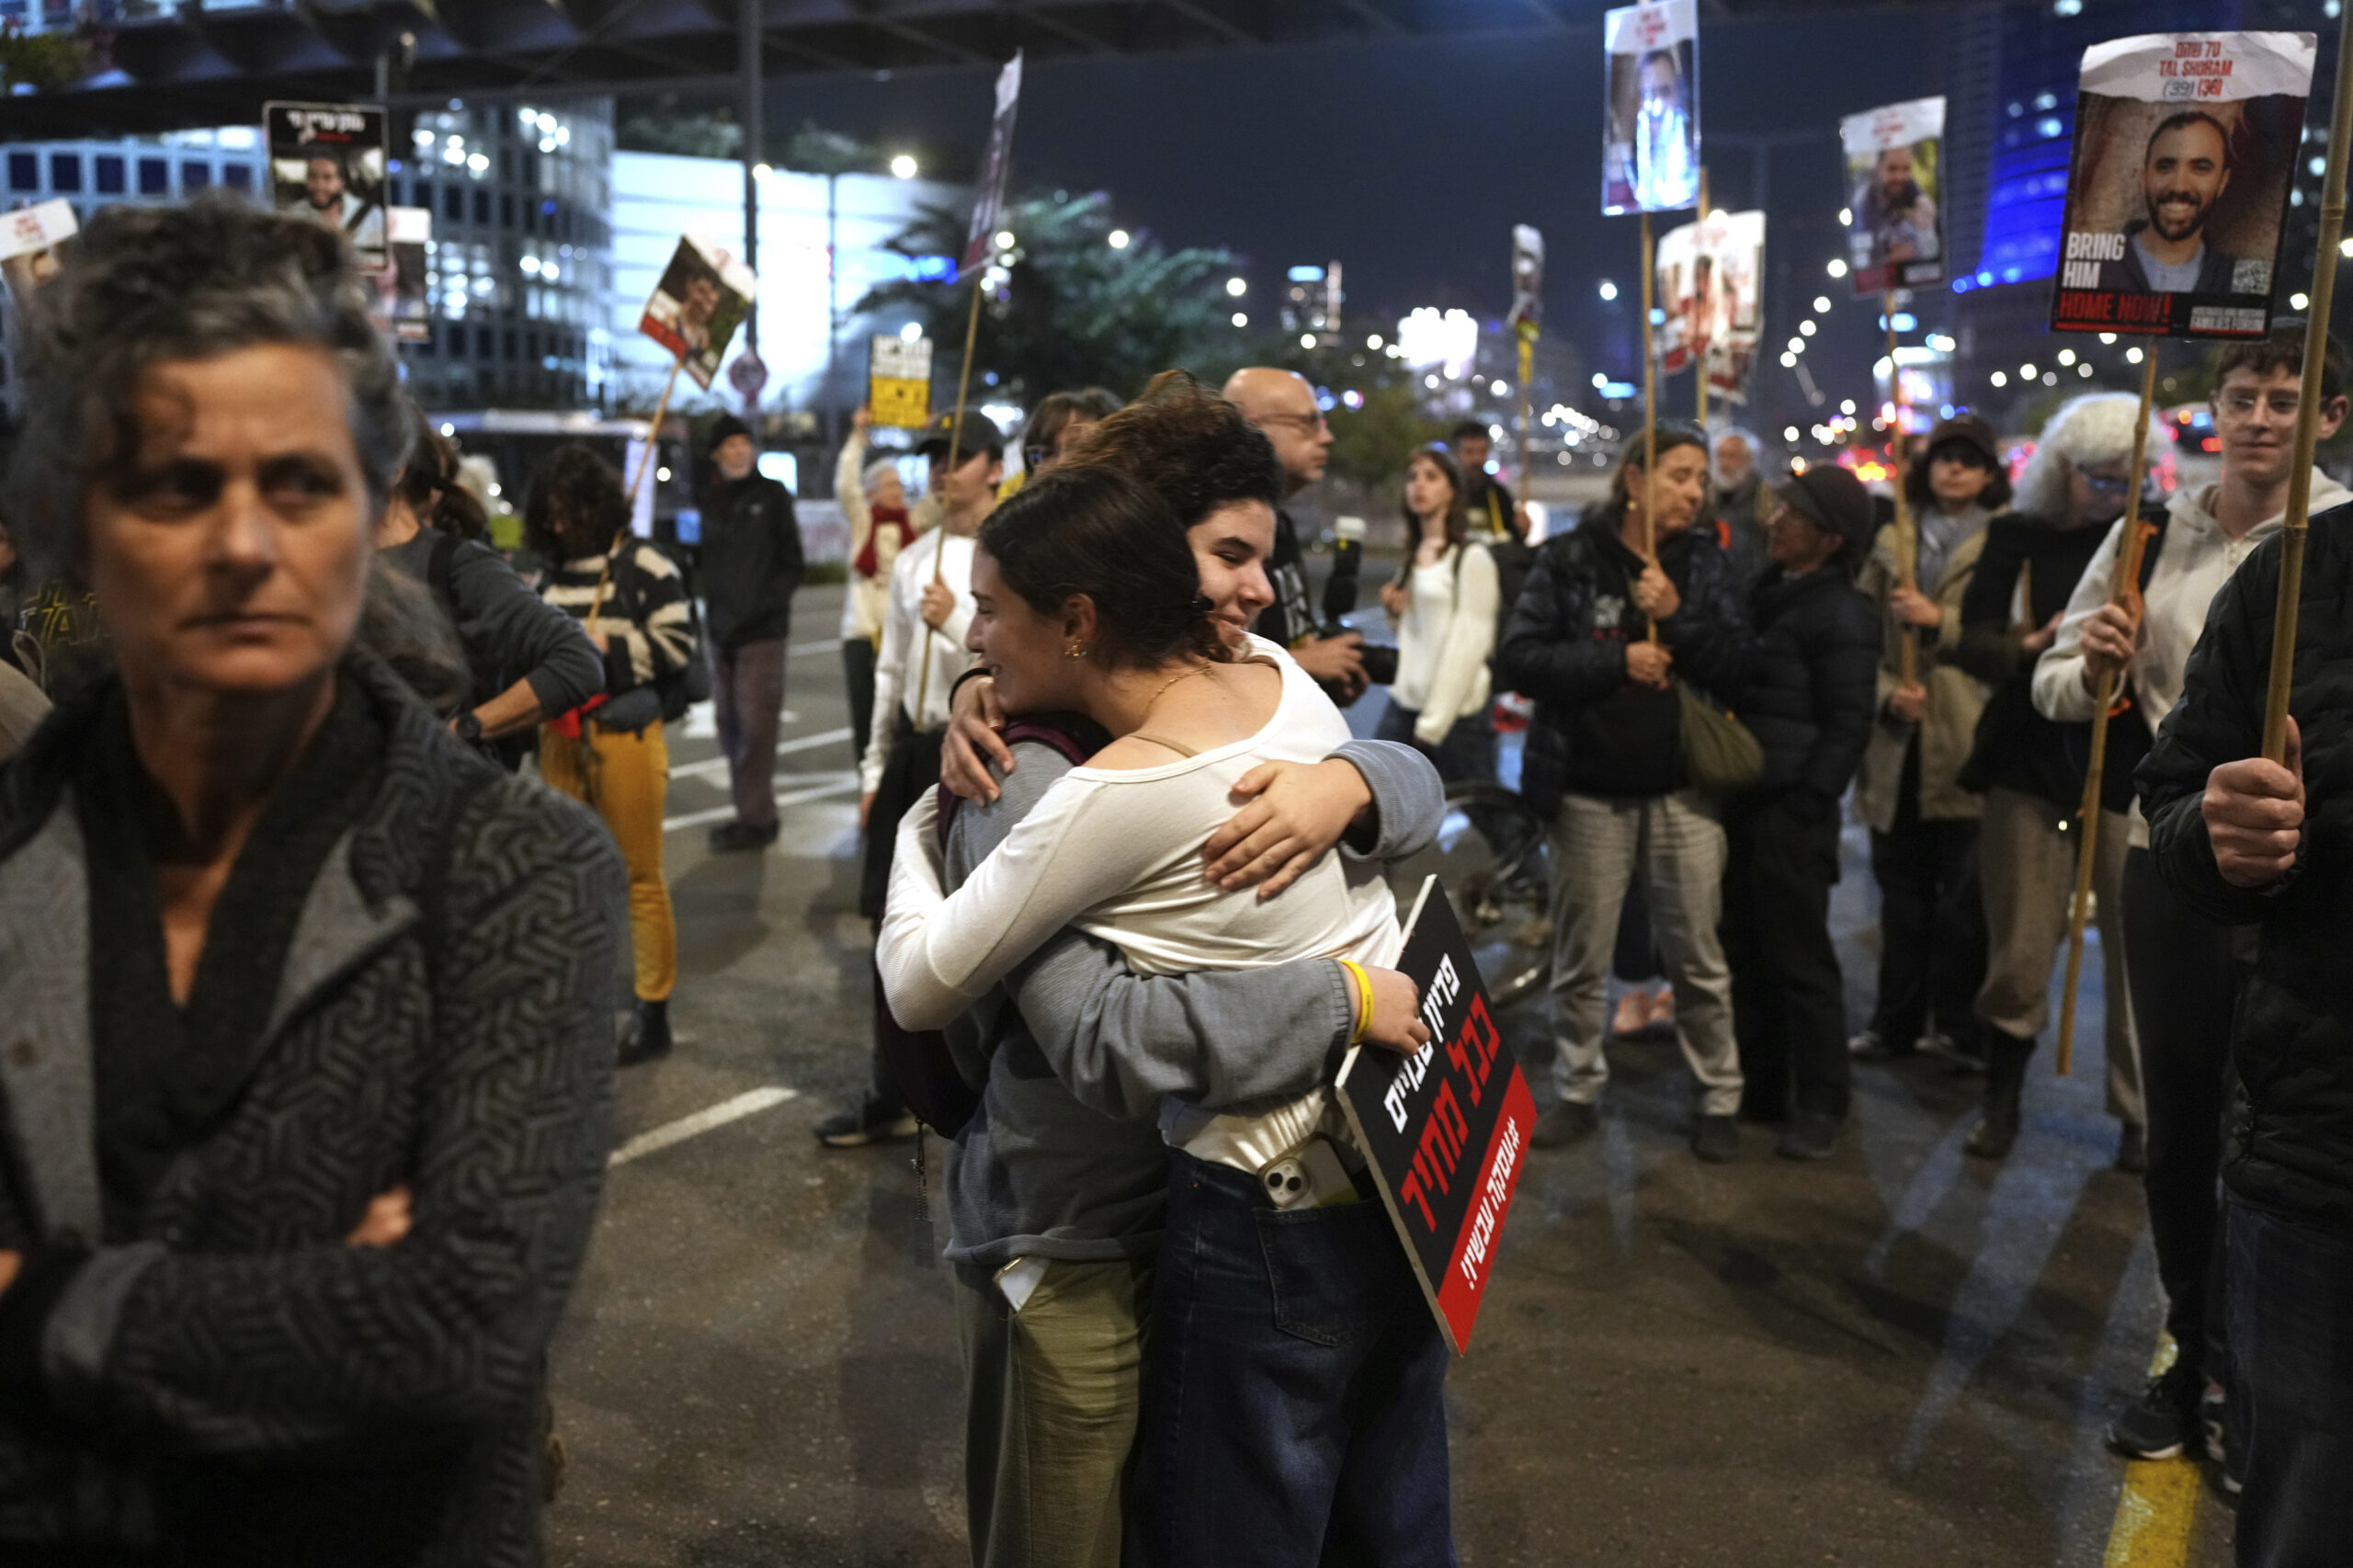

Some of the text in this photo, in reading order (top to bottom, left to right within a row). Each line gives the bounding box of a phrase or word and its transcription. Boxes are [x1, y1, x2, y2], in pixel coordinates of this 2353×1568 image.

[2205, 40, 2222, 58] טל
[2160, 60, 2234, 77] TAL SHOHAM
[2162, 79, 2195, 98] (39)
[2067, 232, 2126, 261] BRING
[2062, 260, 2101, 290] HIM
[2059, 291, 2113, 321] HOME
[2117, 292, 2173, 324] NOW!
[1422, 952, 1461, 1044] פדיון
[1400, 991, 1501, 1233] בכל מחיר
[1460, 1116, 1520, 1290] #עסקה עכשיו!
